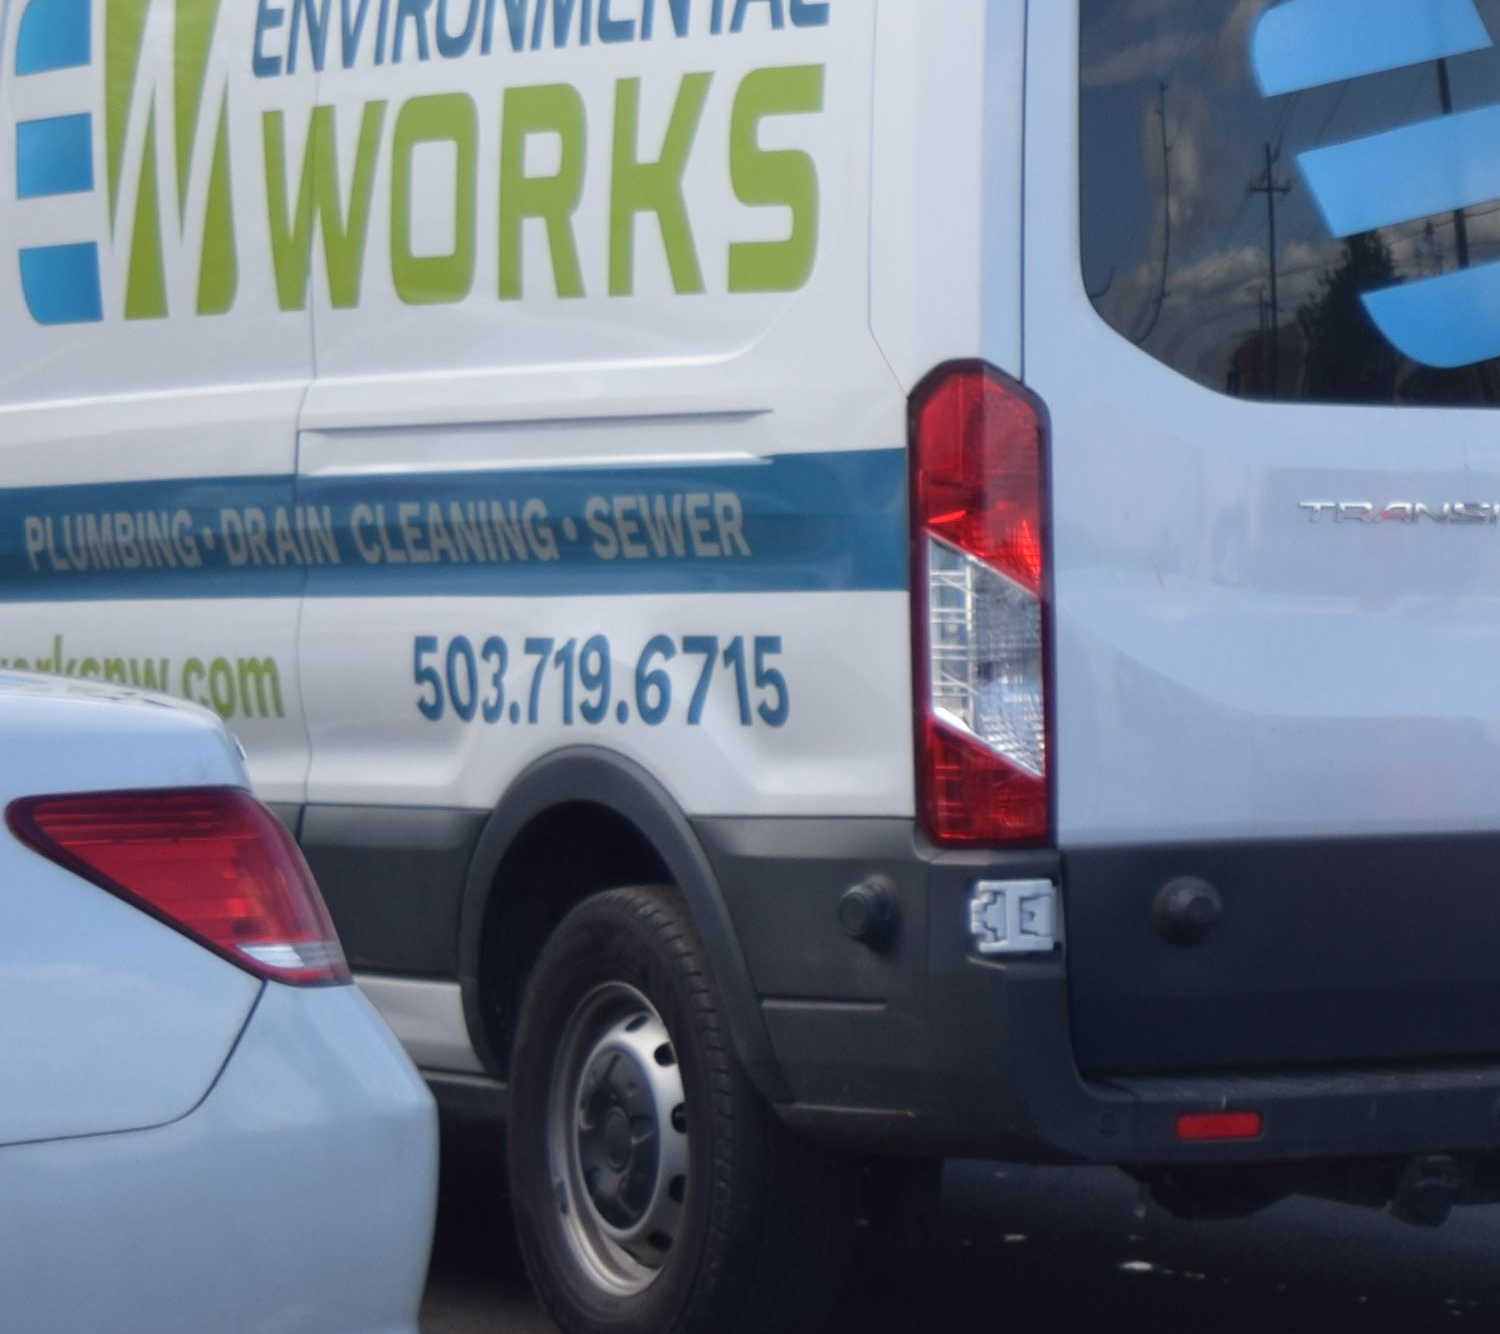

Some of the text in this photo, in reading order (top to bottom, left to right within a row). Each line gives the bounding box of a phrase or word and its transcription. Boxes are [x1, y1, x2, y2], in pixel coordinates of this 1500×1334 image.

[262, 64, 827, 312] WORKS
[25, 491, 752, 571] PLUMBING DRAIN CLEANING SEWER
[413, 633, 790, 729] 503.719.6715
